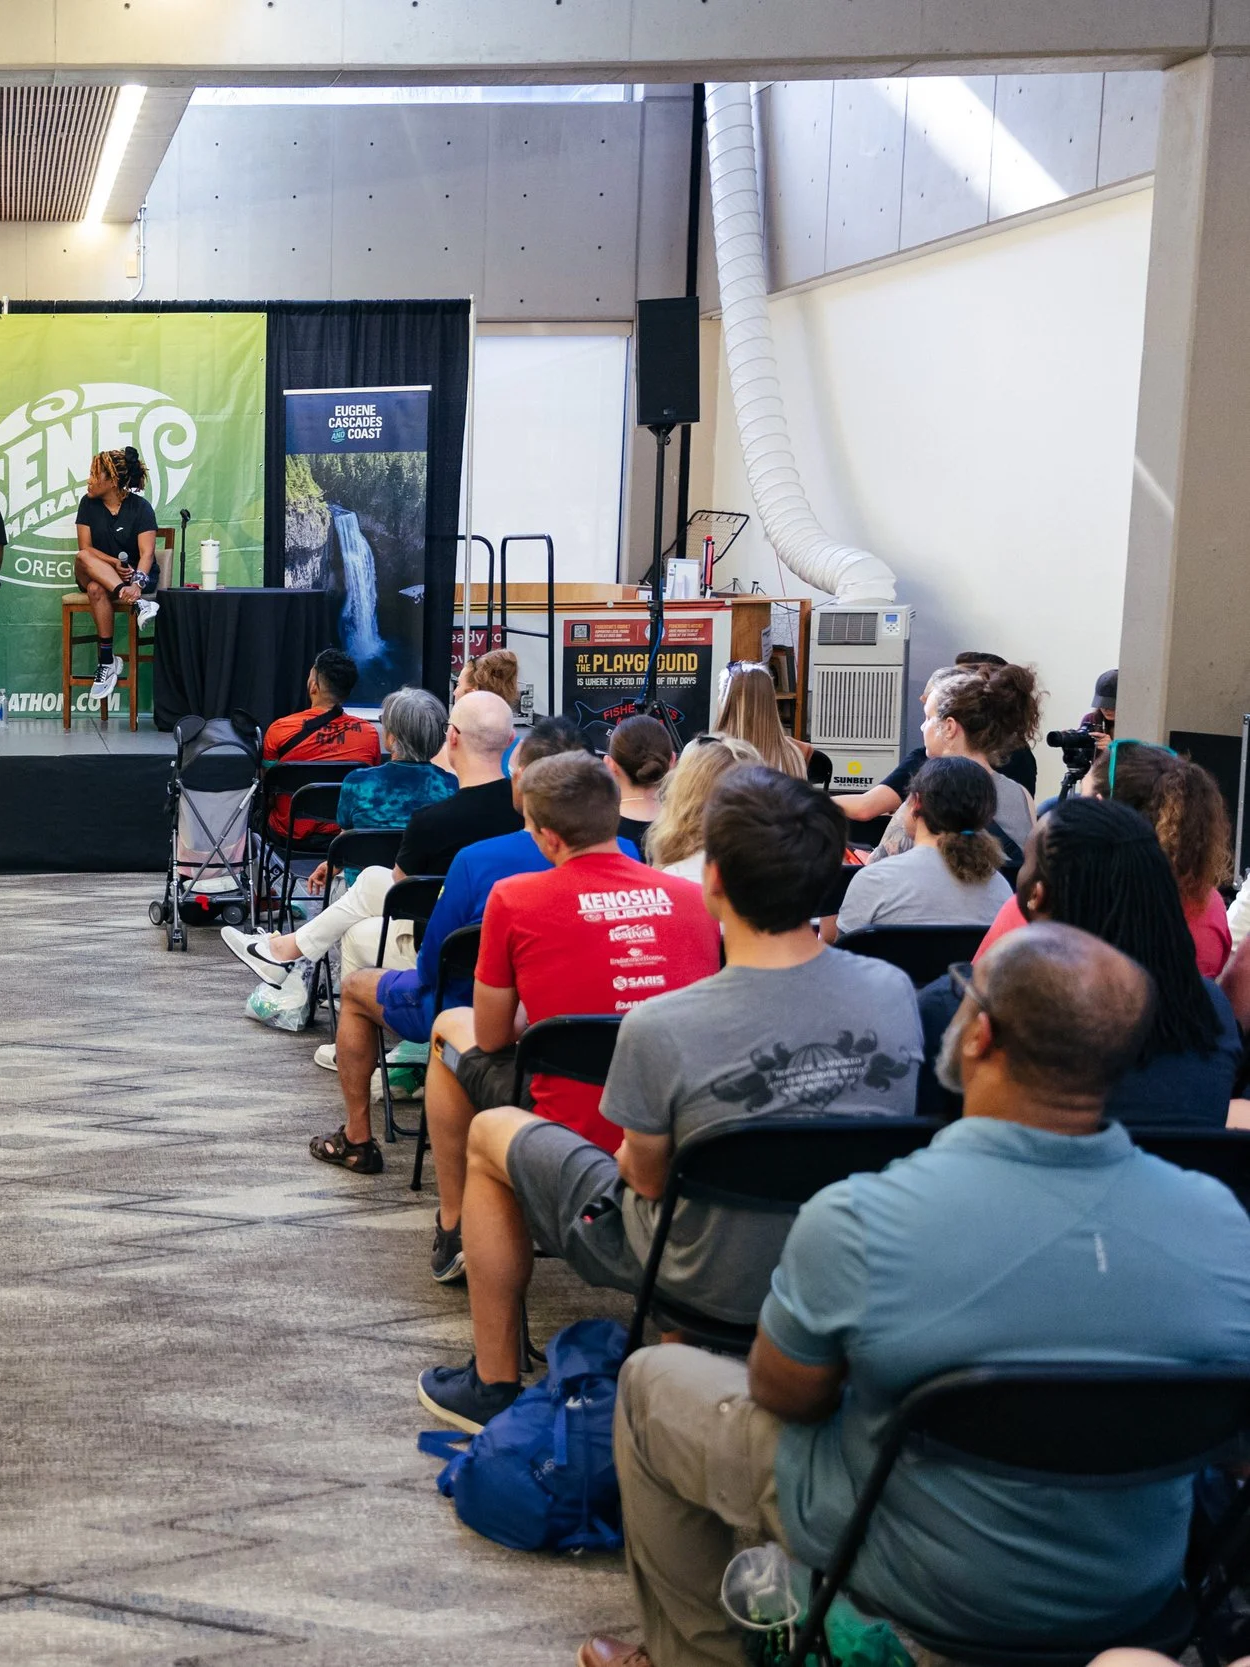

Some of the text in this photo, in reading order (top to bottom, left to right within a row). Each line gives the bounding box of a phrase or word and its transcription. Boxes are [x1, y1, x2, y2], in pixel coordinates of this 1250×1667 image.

[334, 405, 376, 417] EUGENE
[328, 416, 383, 428] CASCADES
[331, 428, 382, 440] AND COAST
[14, 557, 75, 578] OREG
[578, 654, 589, 663] AT
[576, 663, 591, 672] THE
[577, 678, 584, 686] IS
[585, 677, 610, 686] WHERE
[610, 678, 613, 686] I
[614, 677, 635, 686] SPEND
[656, 677, 665, 685] OF
[666, 677, 678, 685] MY
[679, 676, 697, 685] DAYS
[833, 776, 874, 784] SUNBELT
[578, 887, 670, 910] KENOSHA
[604, 906, 672, 921] SUBARU
[608, 924, 655, 942] festival
[628, 975, 665, 988] SARIS
